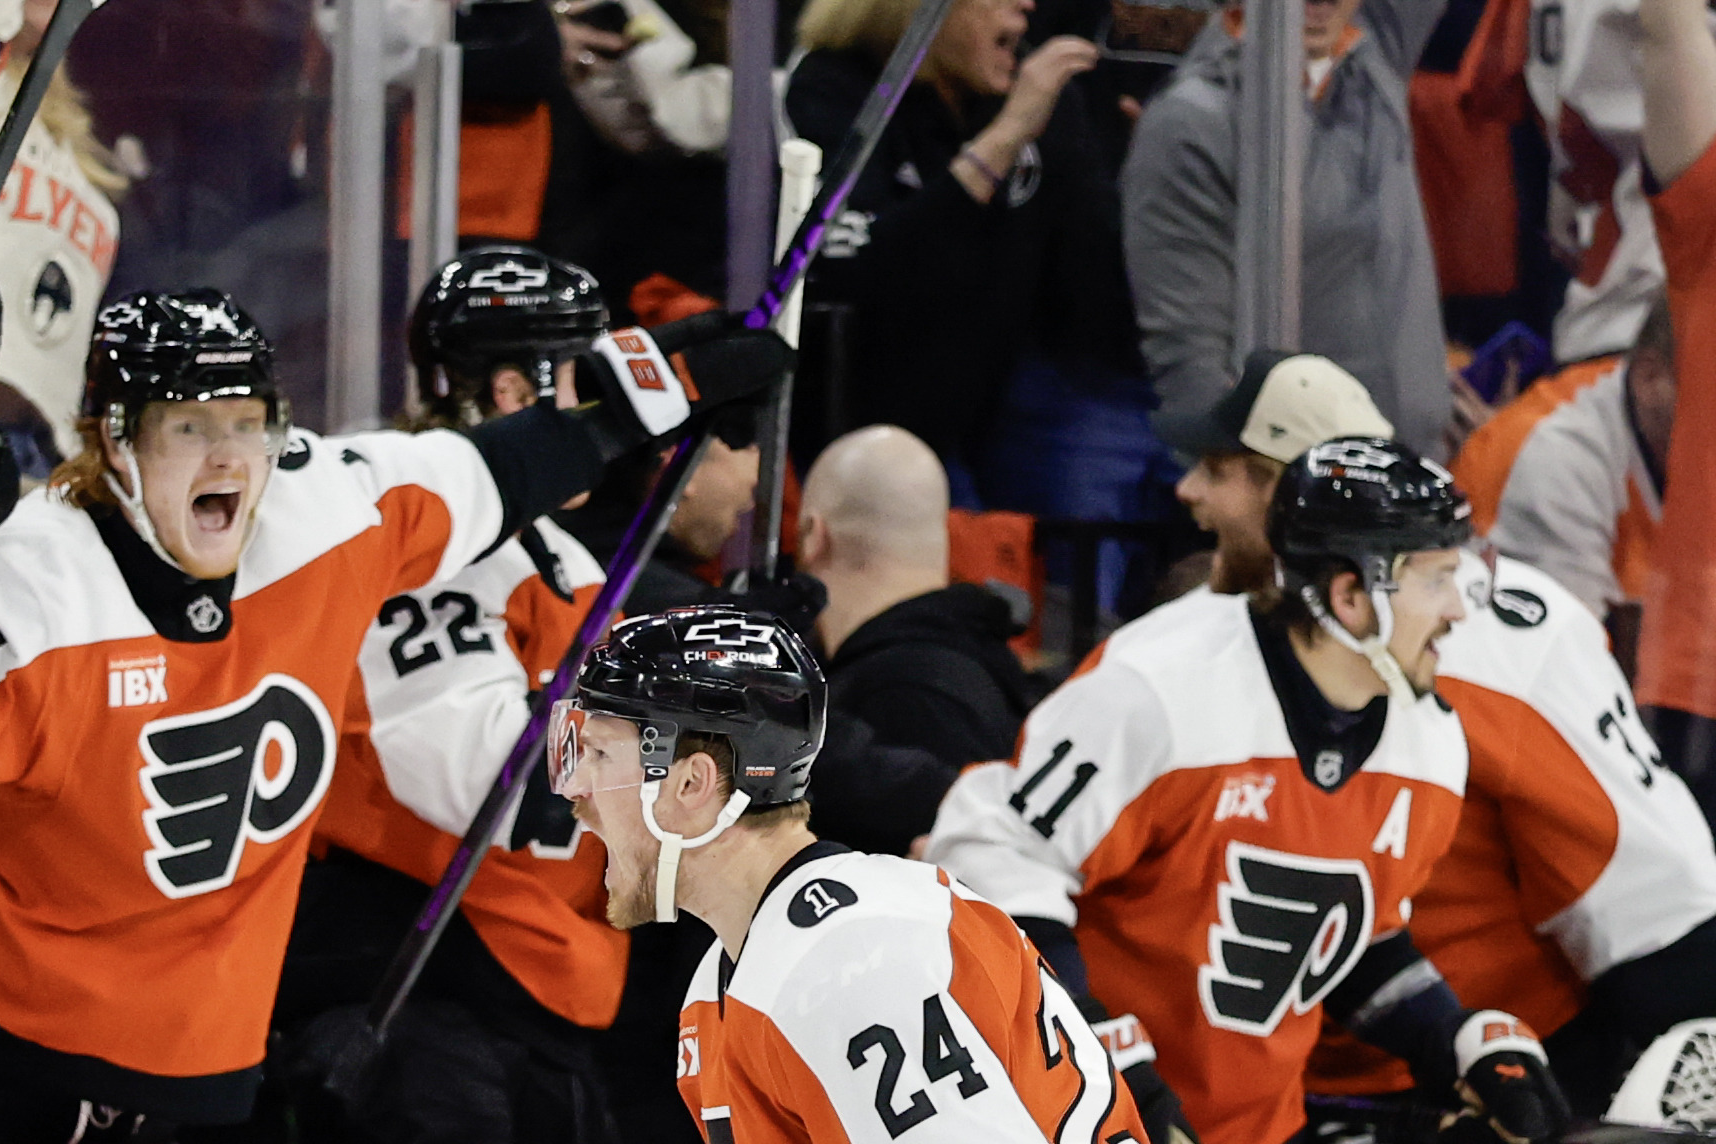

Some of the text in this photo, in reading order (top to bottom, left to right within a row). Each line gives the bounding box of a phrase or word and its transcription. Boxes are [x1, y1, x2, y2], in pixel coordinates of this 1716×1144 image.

[378, 590, 496, 678] 22
[108, 666, 169, 708] IBX
[1008, 739, 1100, 839] 11
[1371, 786, 1414, 860] A
[804, 881, 840, 919] 1
[846, 992, 989, 1140] 24
